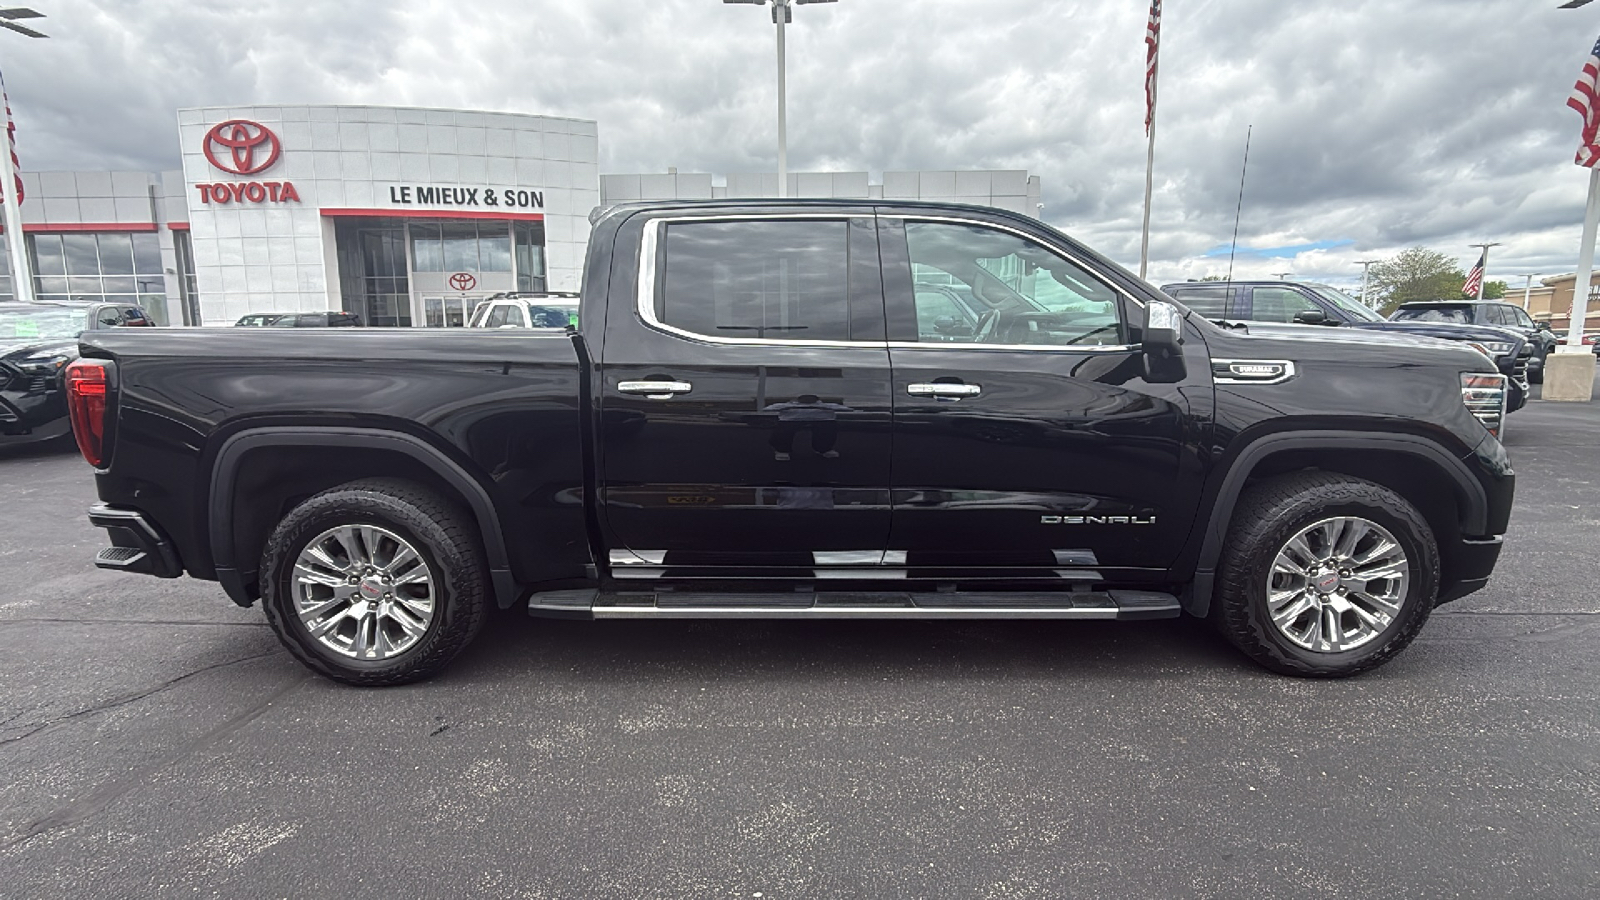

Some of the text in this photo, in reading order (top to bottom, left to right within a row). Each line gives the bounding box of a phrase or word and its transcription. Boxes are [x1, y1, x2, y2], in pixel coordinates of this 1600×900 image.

[195, 181, 301, 204] TOYOTA
[389, 186, 544, 208] LE MIEUX & SON
[1040, 515, 1156, 524] DENALI
